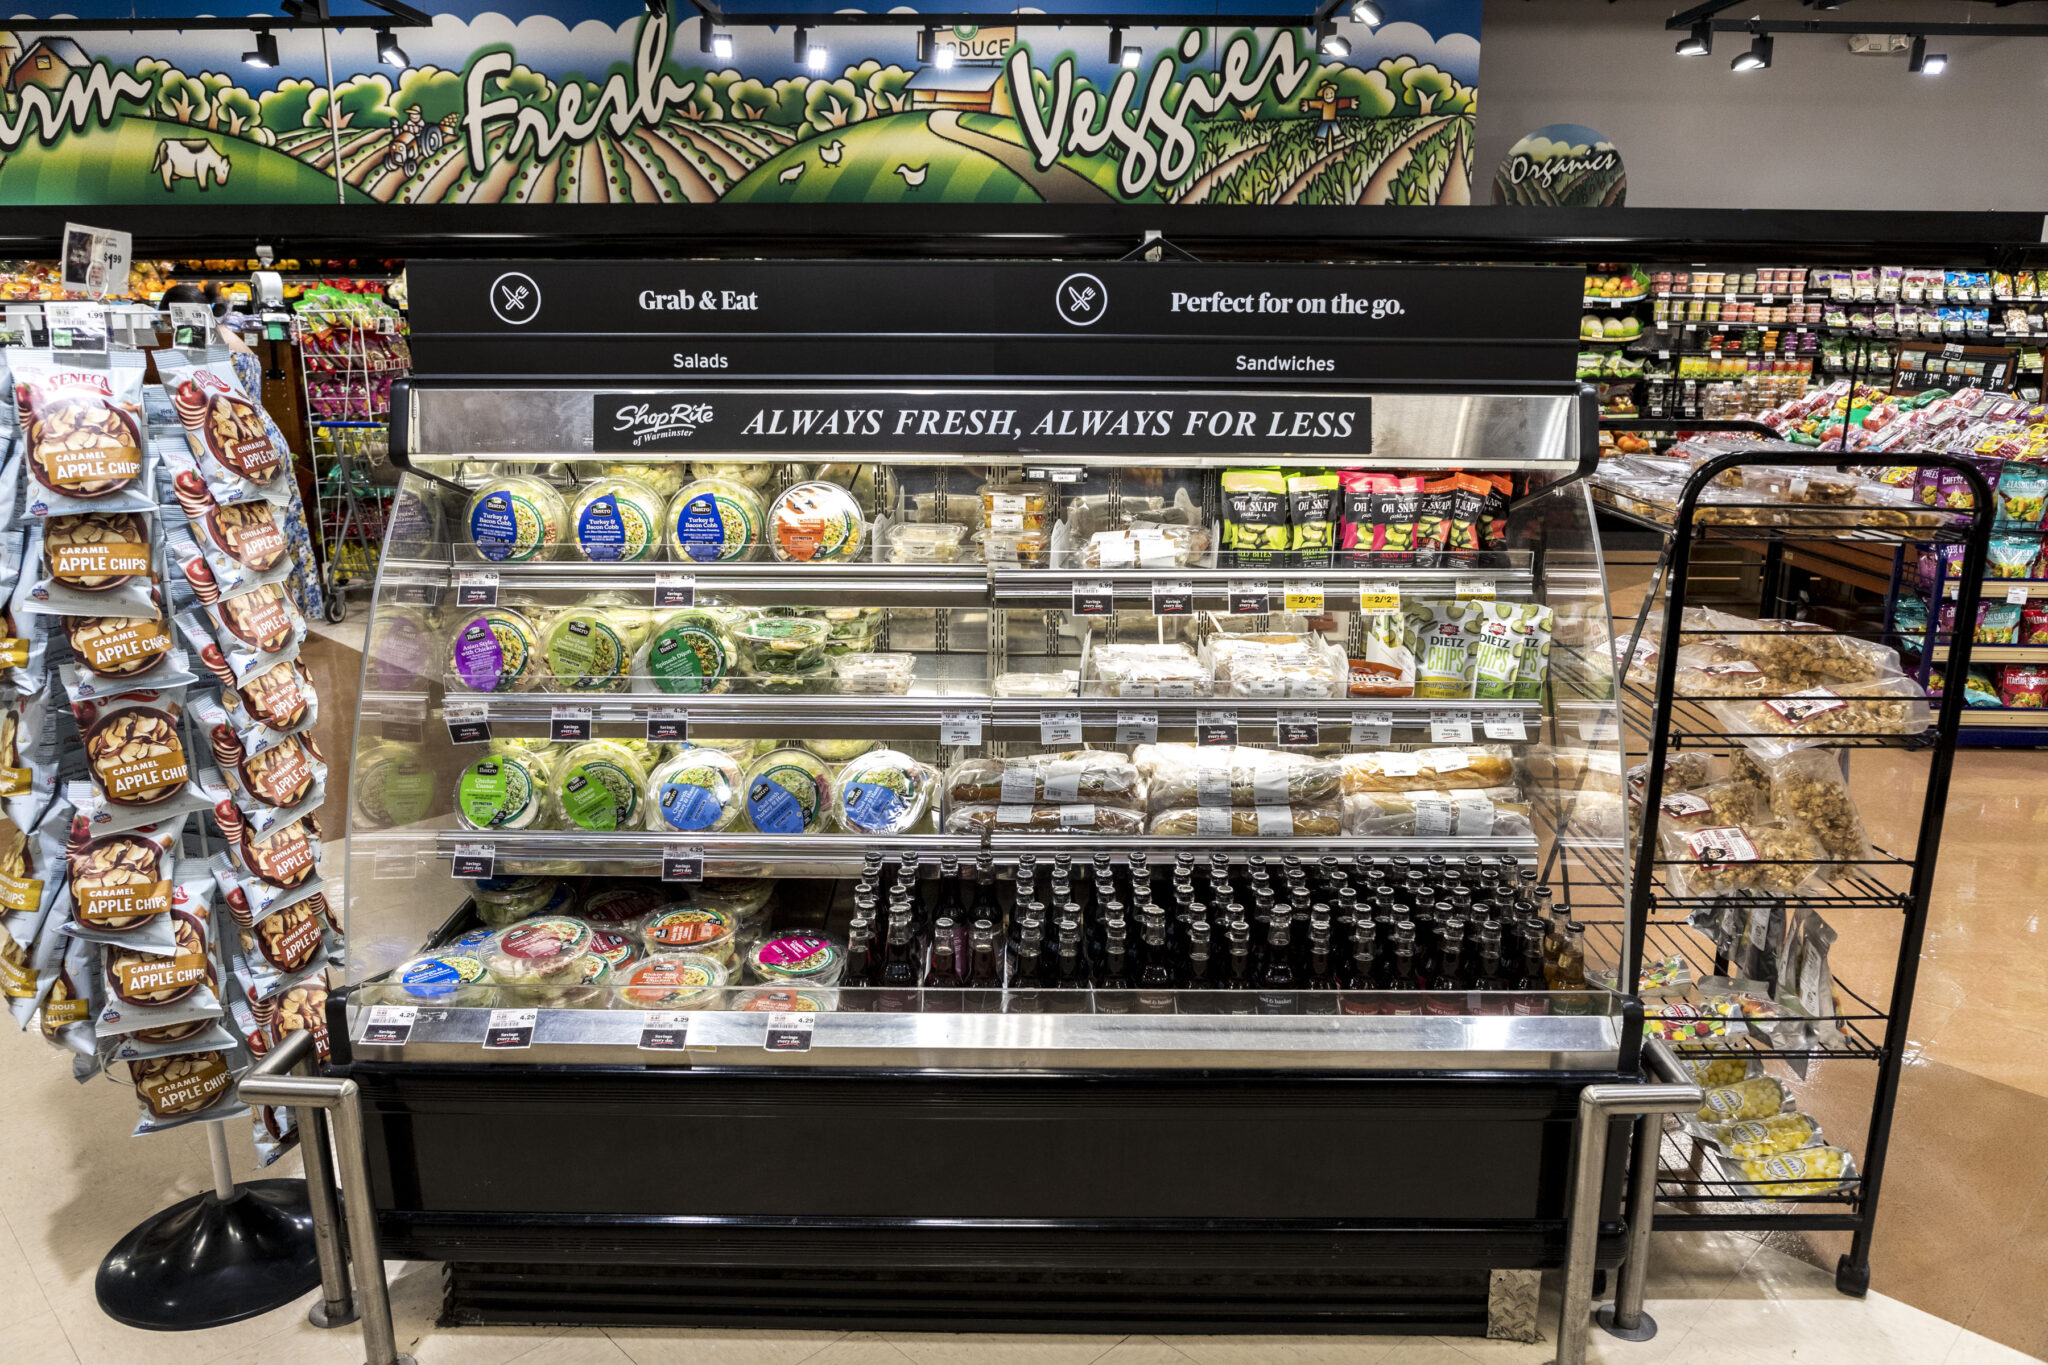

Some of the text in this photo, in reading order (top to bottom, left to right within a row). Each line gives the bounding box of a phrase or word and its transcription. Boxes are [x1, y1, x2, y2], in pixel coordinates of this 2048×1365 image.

[463, 9, 697, 177] Fresh
[0, 62, 151, 147] rm
[1007, 29, 1311, 194] Veggies
[1510, 149, 1617, 188] Organics
[638, 289, 758, 311] Grab & Eat
[1170, 290, 1405, 320] Perfect for on the go.
[673, 353, 729, 369] Salads
[1235, 354, 1336, 372] Sandwiches
[48, 373, 114, 397] SENECA
[613, 402, 714, 432] ShopRite
[741, 409, 1356, 440] ALWAYS FRESH, ALWAYS FOR LESS
[633, 428, 694, 447] of Warminster
[56, 452, 106, 463] CARAMEL
[243, 451, 266, 470] APPLE
[57, 461, 105, 480] APPLE
[593, 507, 612, 515] Bistro
[1234, 501, 1278, 513] OH SNAP!
[1298, 501, 1309, 511] OH
[1354, 502, 1367, 512] OH
[1382, 503, 1394, 513] OH
[60, 546, 110, 554] CARAMEL
[58, 557, 146, 572] APPLE CHIPS
[92, 630, 139, 648] CARAMEL
[570, 625, 589, 635] Bistro
[1430, 636, 1465, 647] DIETZ
[96, 641, 141, 665] APPLE
[1427, 648, 1465, 672] CHIPS
[112, 760, 159, 776] CARAMEL
[115, 764, 188, 793] APPLE CHIP
[275, 851, 304, 877] APPLE
[89, 888, 135, 898] CARAMEL
[87, 895, 168, 915] APPLE CHIPS
[285, 937, 311, 962] APPLE
[130, 961, 176, 974] CARAMEL
[129, 973, 174, 991] APPLE
[157, 1075, 201, 1095] CARAMEL
[160, 1085, 202, 1109] APPLE
